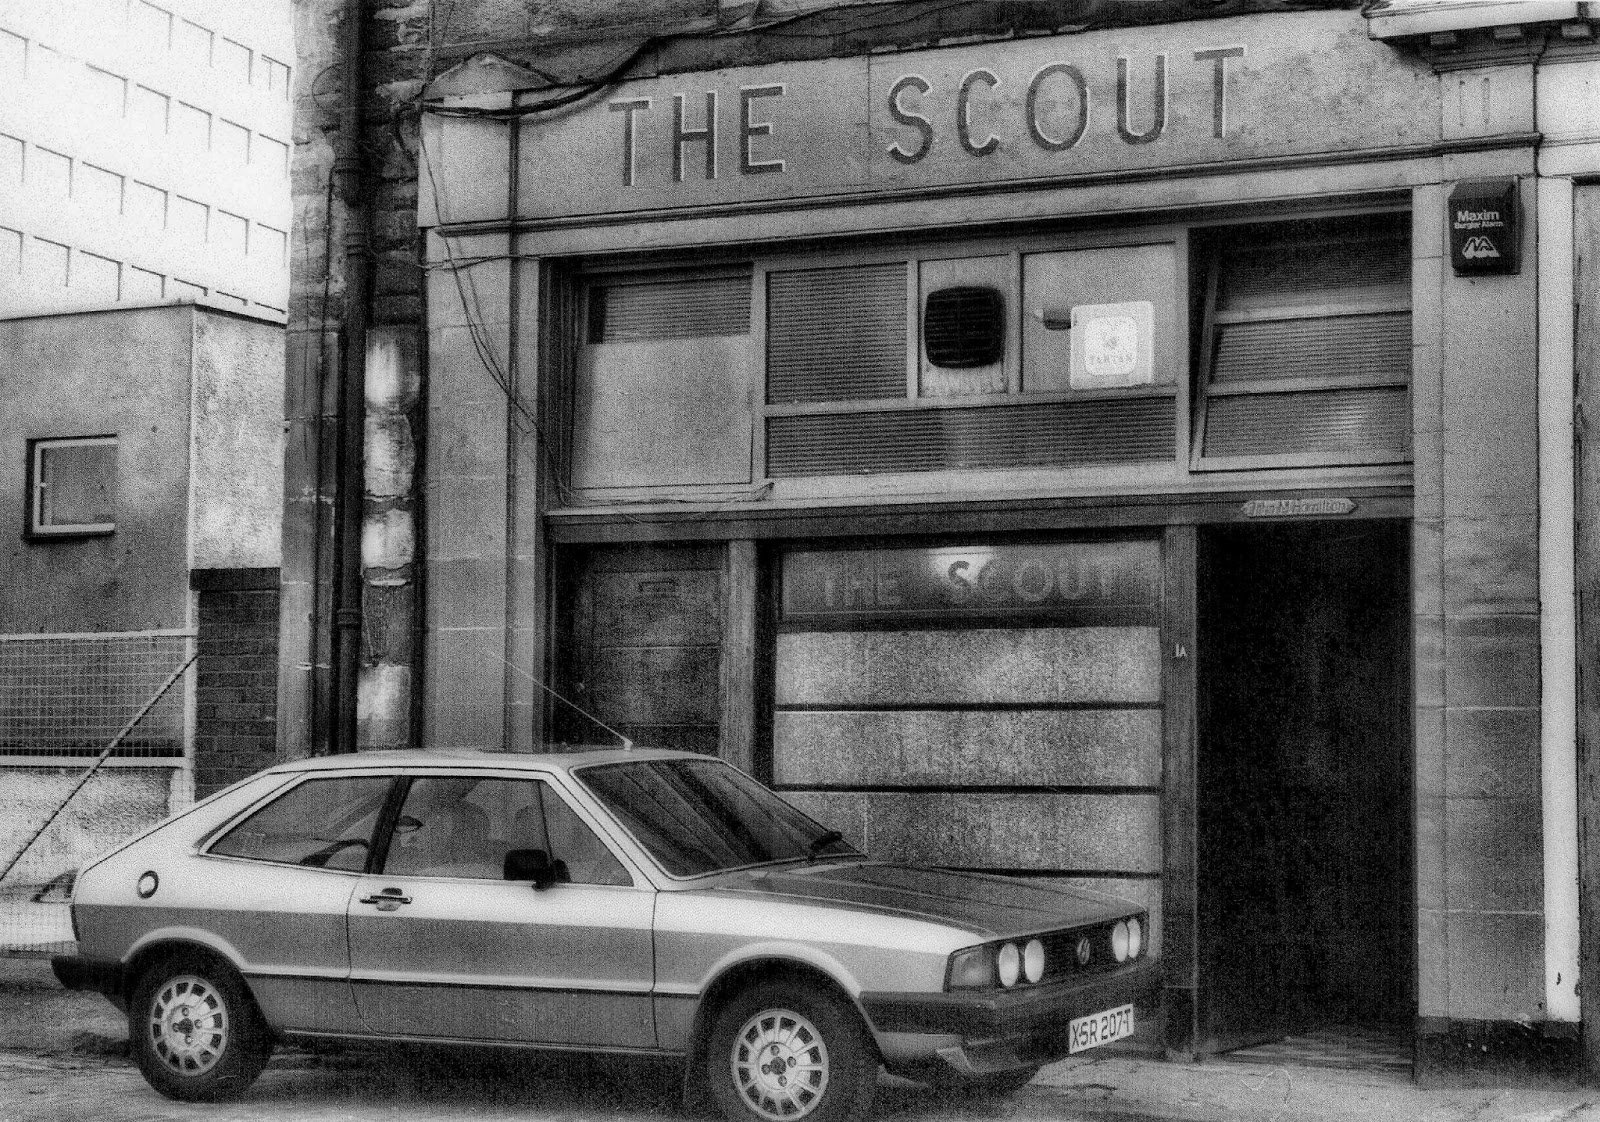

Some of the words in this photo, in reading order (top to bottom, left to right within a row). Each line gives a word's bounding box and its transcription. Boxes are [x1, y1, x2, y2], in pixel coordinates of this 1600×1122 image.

[608, 83, 786, 187] THE
[884, 46, 1246, 165] SCOUT
[1457, 209, 1500, 222] Maxim
[818, 568, 903, 608] THE
[947, 556, 1122, 604] SCOUT
[1072, 1019, 1098, 1049] XSR
[1101, 1008, 1131, 1040] 207T
